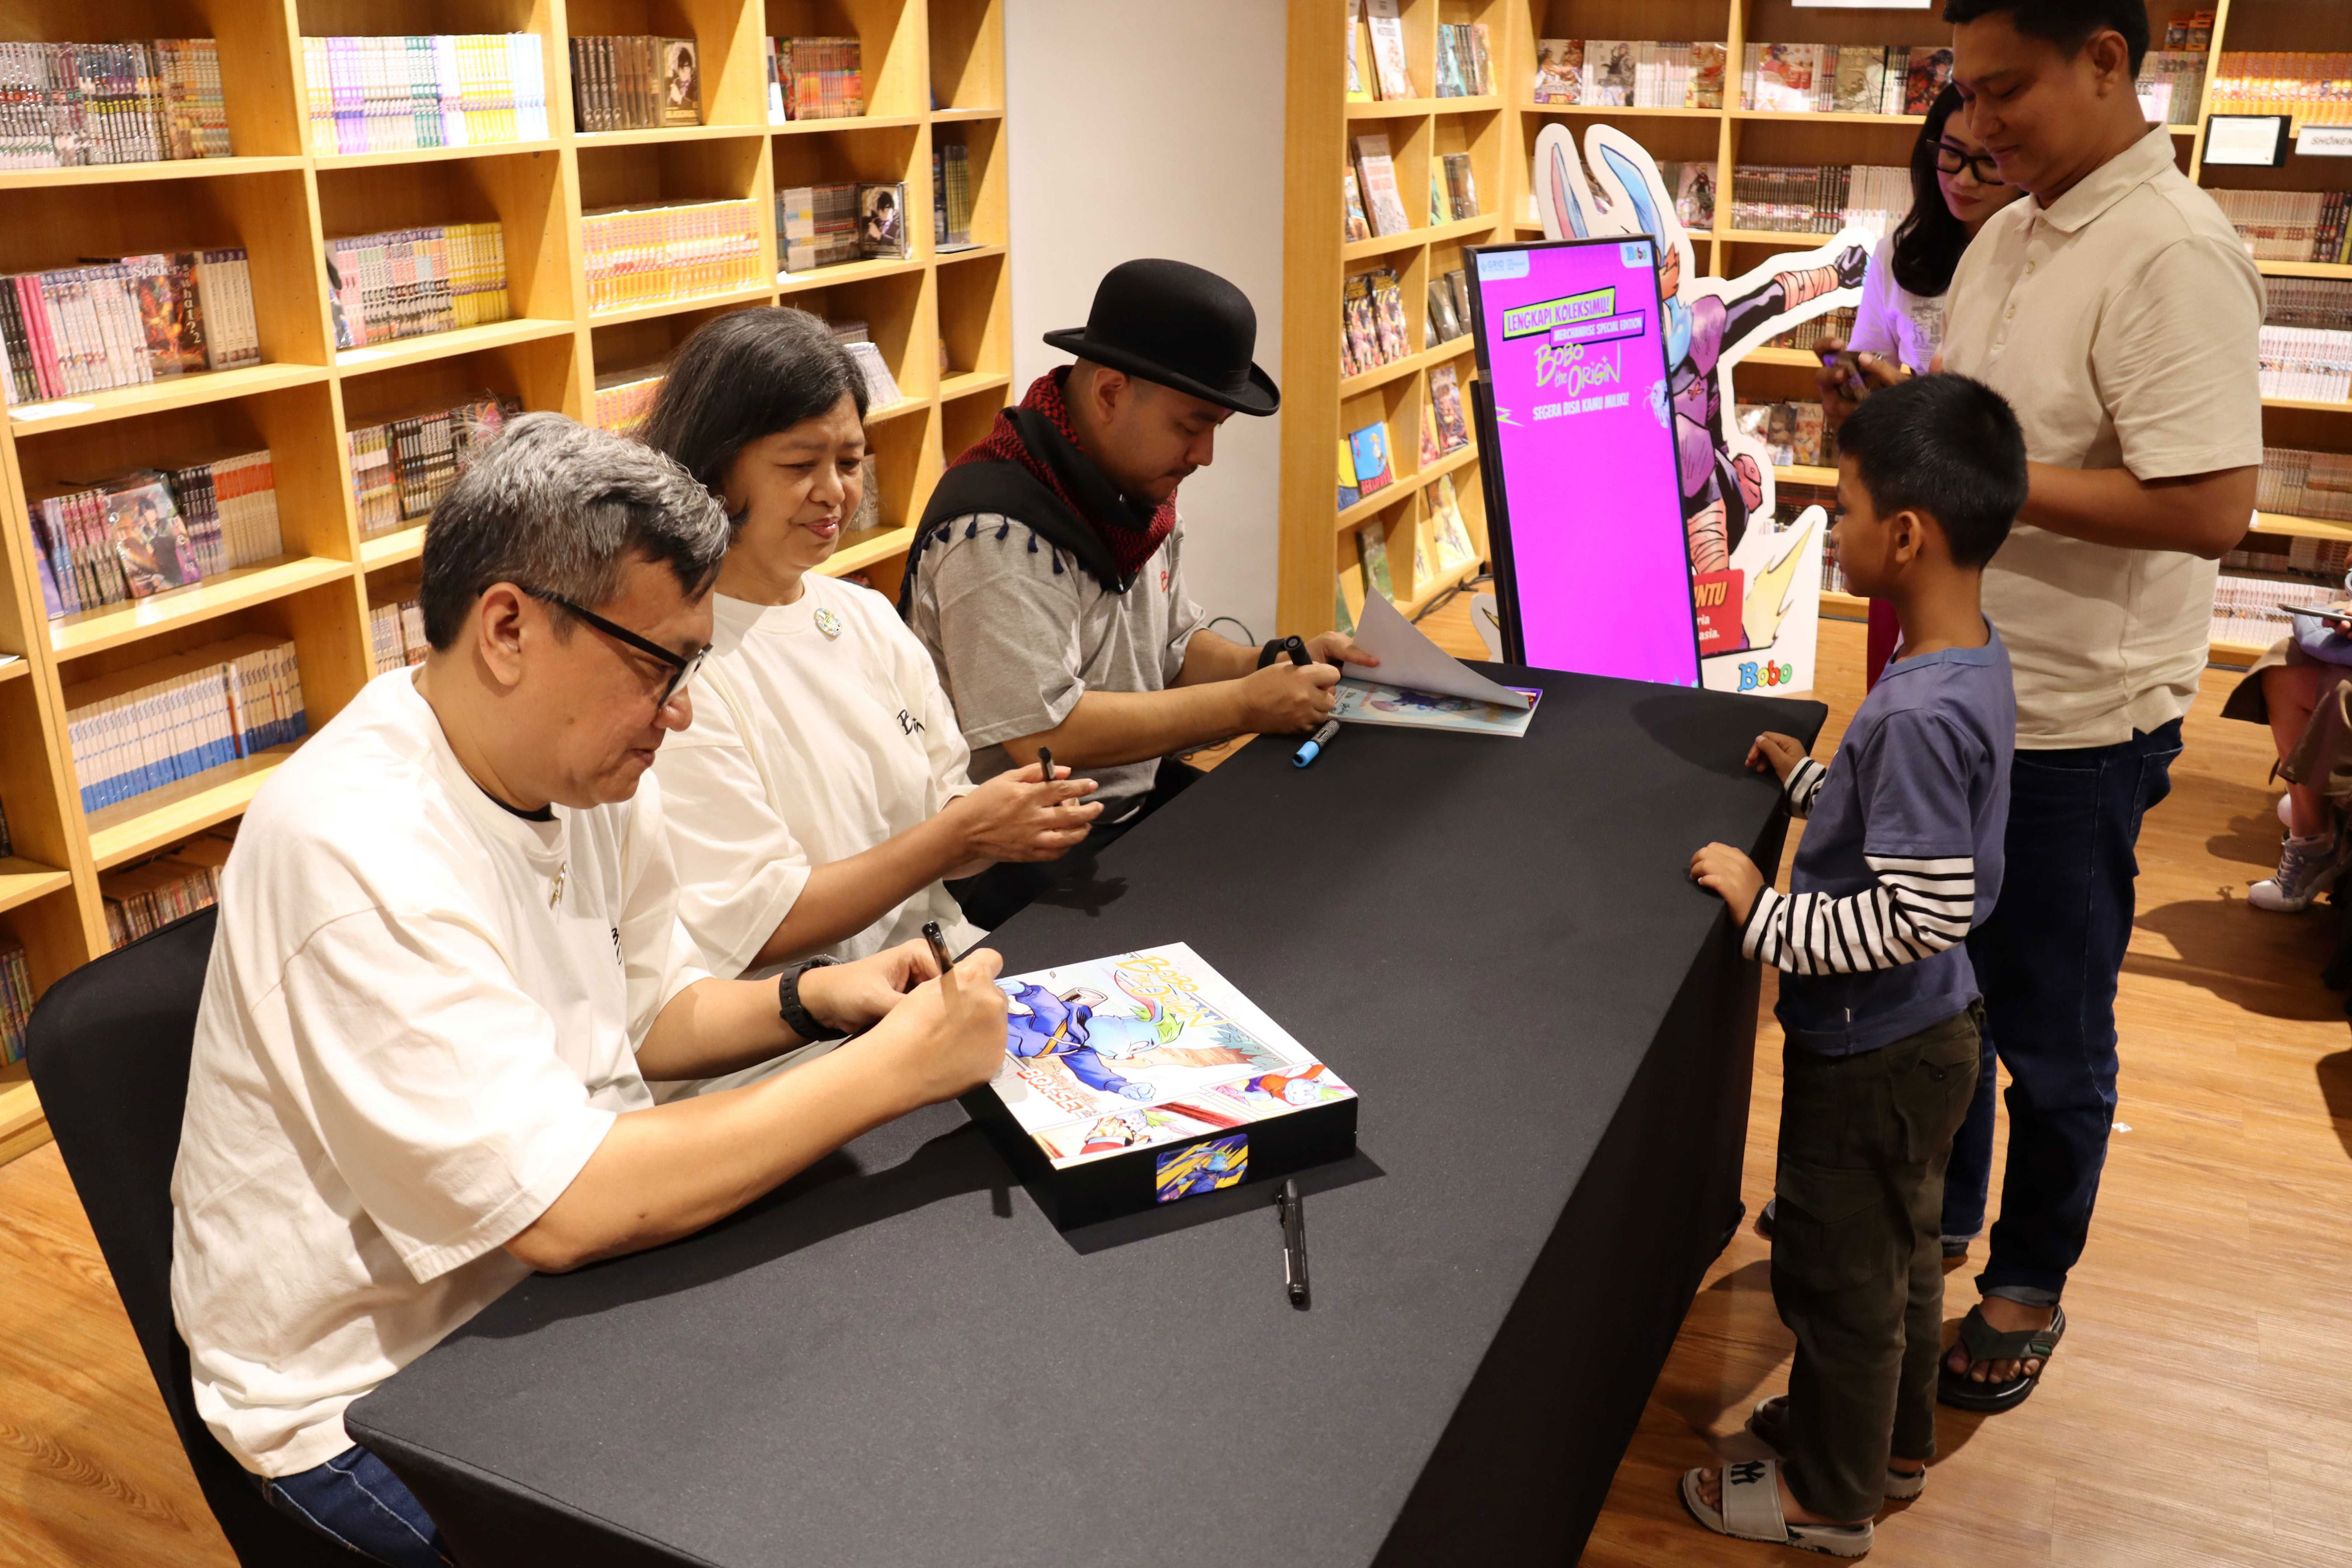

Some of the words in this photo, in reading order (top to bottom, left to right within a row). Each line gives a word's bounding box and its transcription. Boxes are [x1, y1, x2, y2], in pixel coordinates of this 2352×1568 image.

[1487, 259, 1504, 269] GRID
[1507, 309, 1552, 332] LENGKAPI
[1555, 296, 1610, 323] KOLEKSIMU!
[1553, 324, 1595, 342] MERCHANDISE
[1597, 320, 1619, 334] SPECIAL
[1620, 317, 1642, 330] EDITION
[1555, 369, 1567, 388] the
[1533, 403, 1562, 421] SEGERA
[1563, 399, 1581, 416] BISA
[1581, 396, 1604, 413] KAMU
[1604, 391, 1630, 409] MILIKI!
[1737, 660, 1792, 692] Bobo
